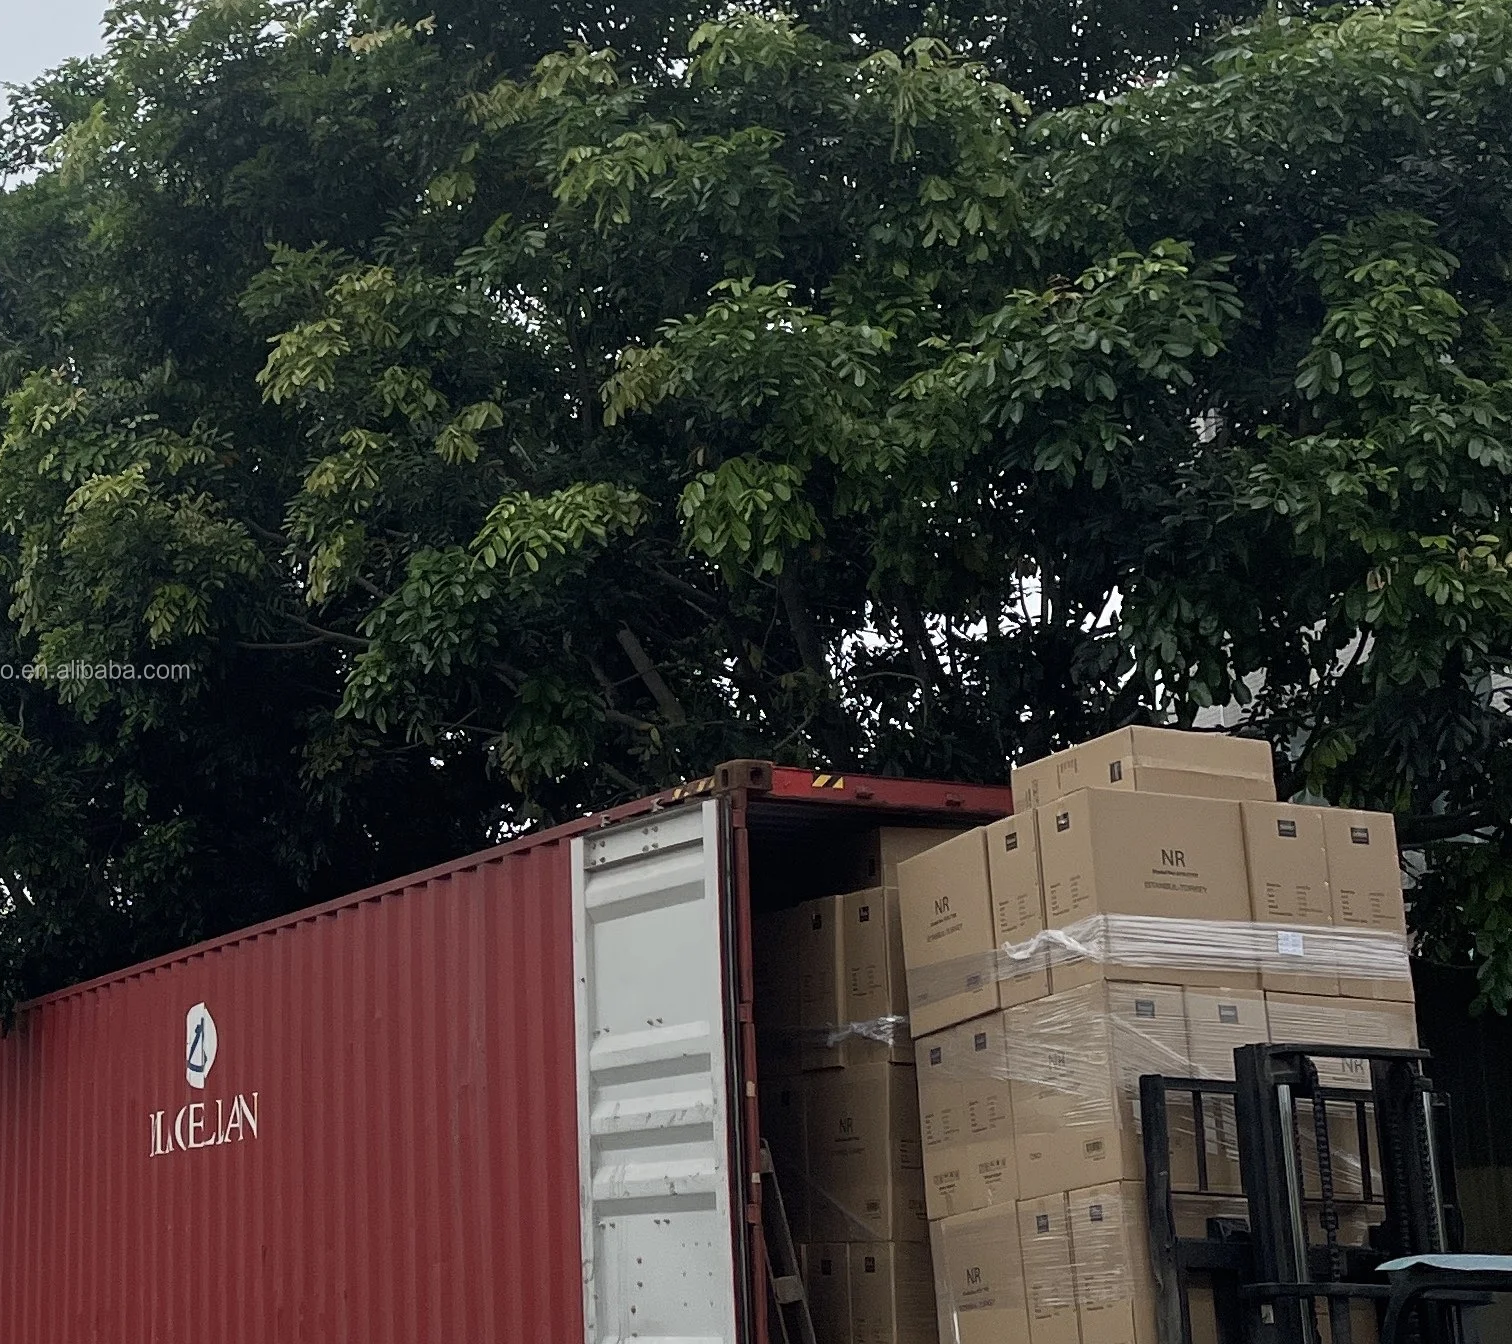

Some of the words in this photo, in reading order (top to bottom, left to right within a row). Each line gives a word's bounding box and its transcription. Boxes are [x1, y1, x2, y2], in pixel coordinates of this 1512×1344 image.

[1161, 849, 1186, 867] NR
[935, 896, 950, 915] NR
[966, 1267, 981, 1284] NR
